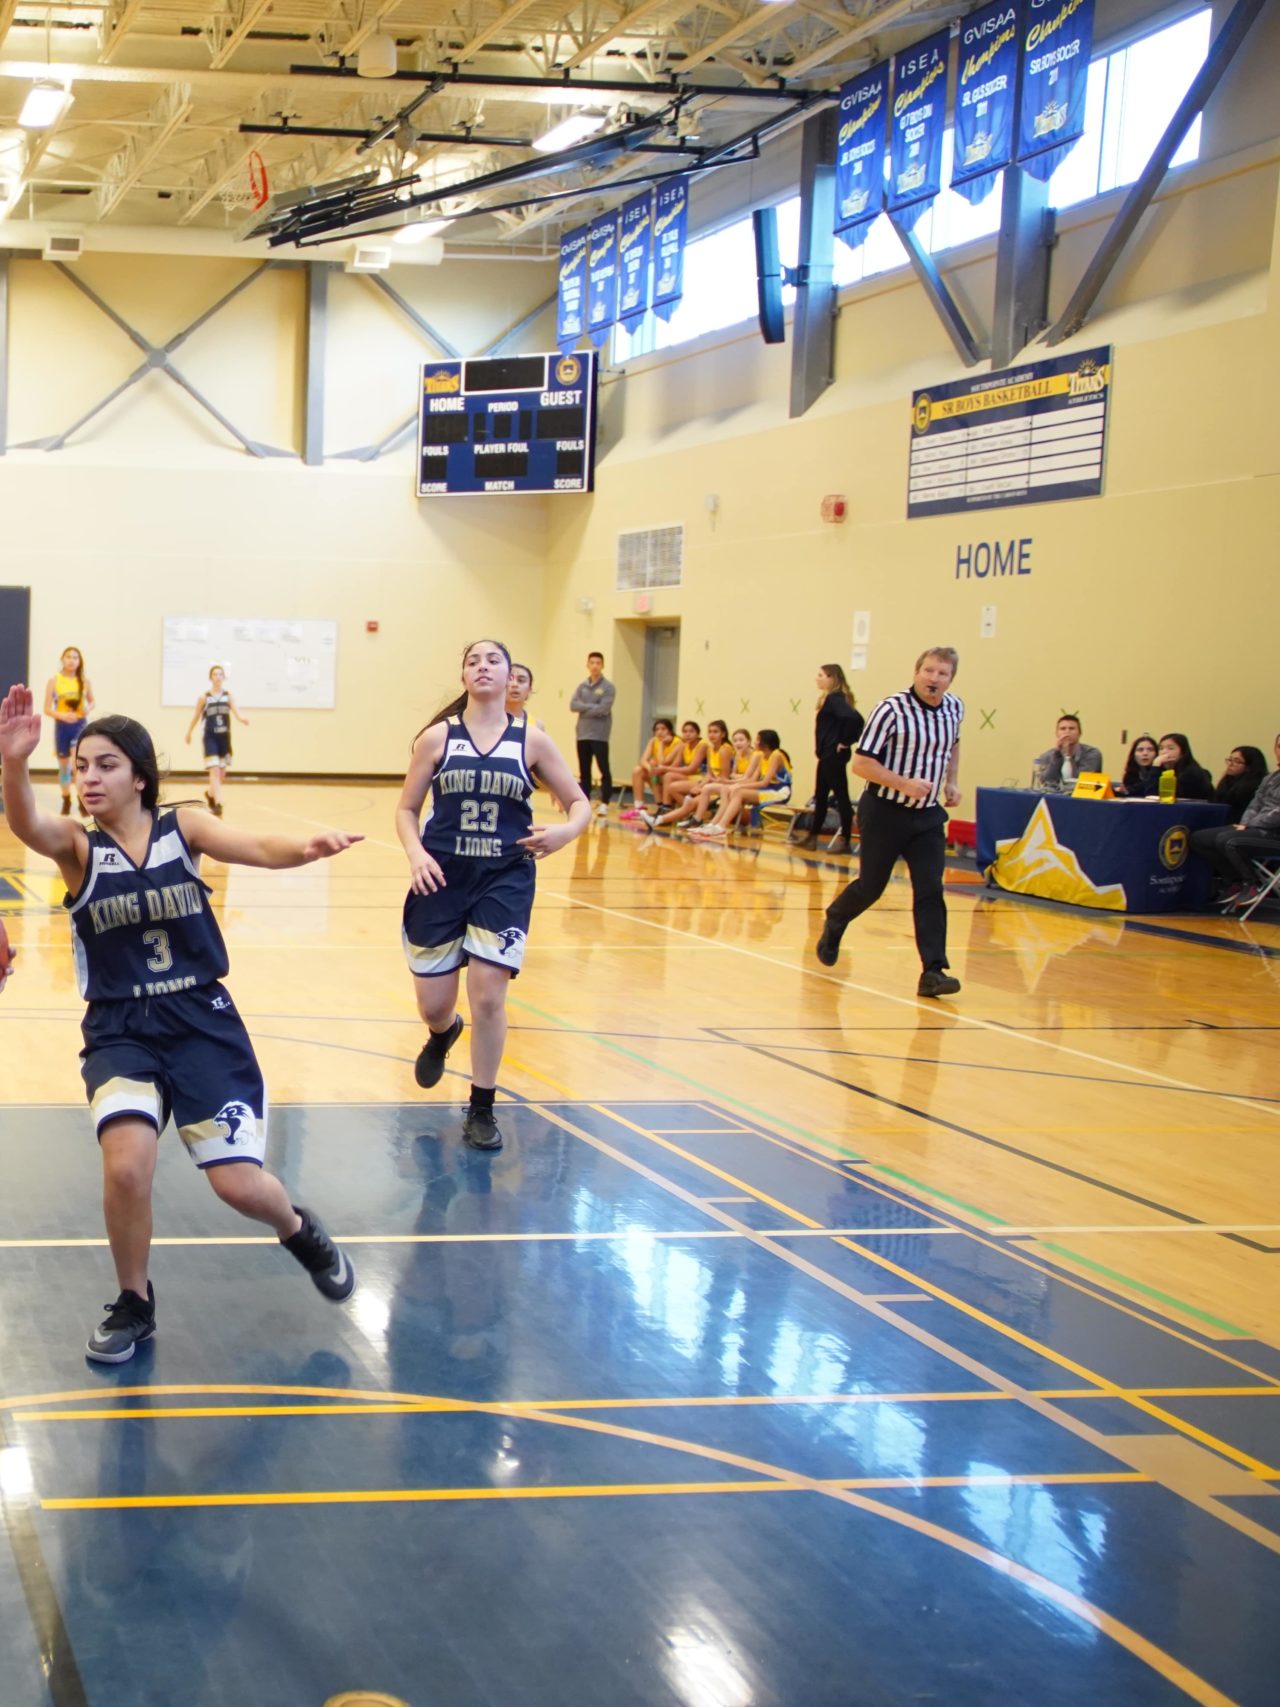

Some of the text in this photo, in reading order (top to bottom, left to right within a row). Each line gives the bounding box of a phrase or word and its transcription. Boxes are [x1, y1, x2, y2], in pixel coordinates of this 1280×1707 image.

[964, 8, 1016, 44] GVISAA
[429, 397, 465, 412] HOME
[540, 390, 582, 406] GUEST
[955, 397, 982, 413] BOYS
[983, 380, 1053, 404] BASKETBALL
[488, 401, 518, 413] PERIOD
[422, 446, 449, 456] FOULS
[474, 442, 529, 454] PLAYER FOUL
[556, 440, 584, 451] FOULS
[421, 483, 448, 493] SCORE
[485, 480, 515, 491] MATCH
[554, 478, 582, 489] SCORE
[955, 538, 1033, 580] HOME
[440, 769, 476, 796] KING
[460, 800, 500, 834] 23
[455, 836, 503, 858] LIONS
[88, 880, 204, 935] KING DAVID
[142, 928, 174, 973] 3
